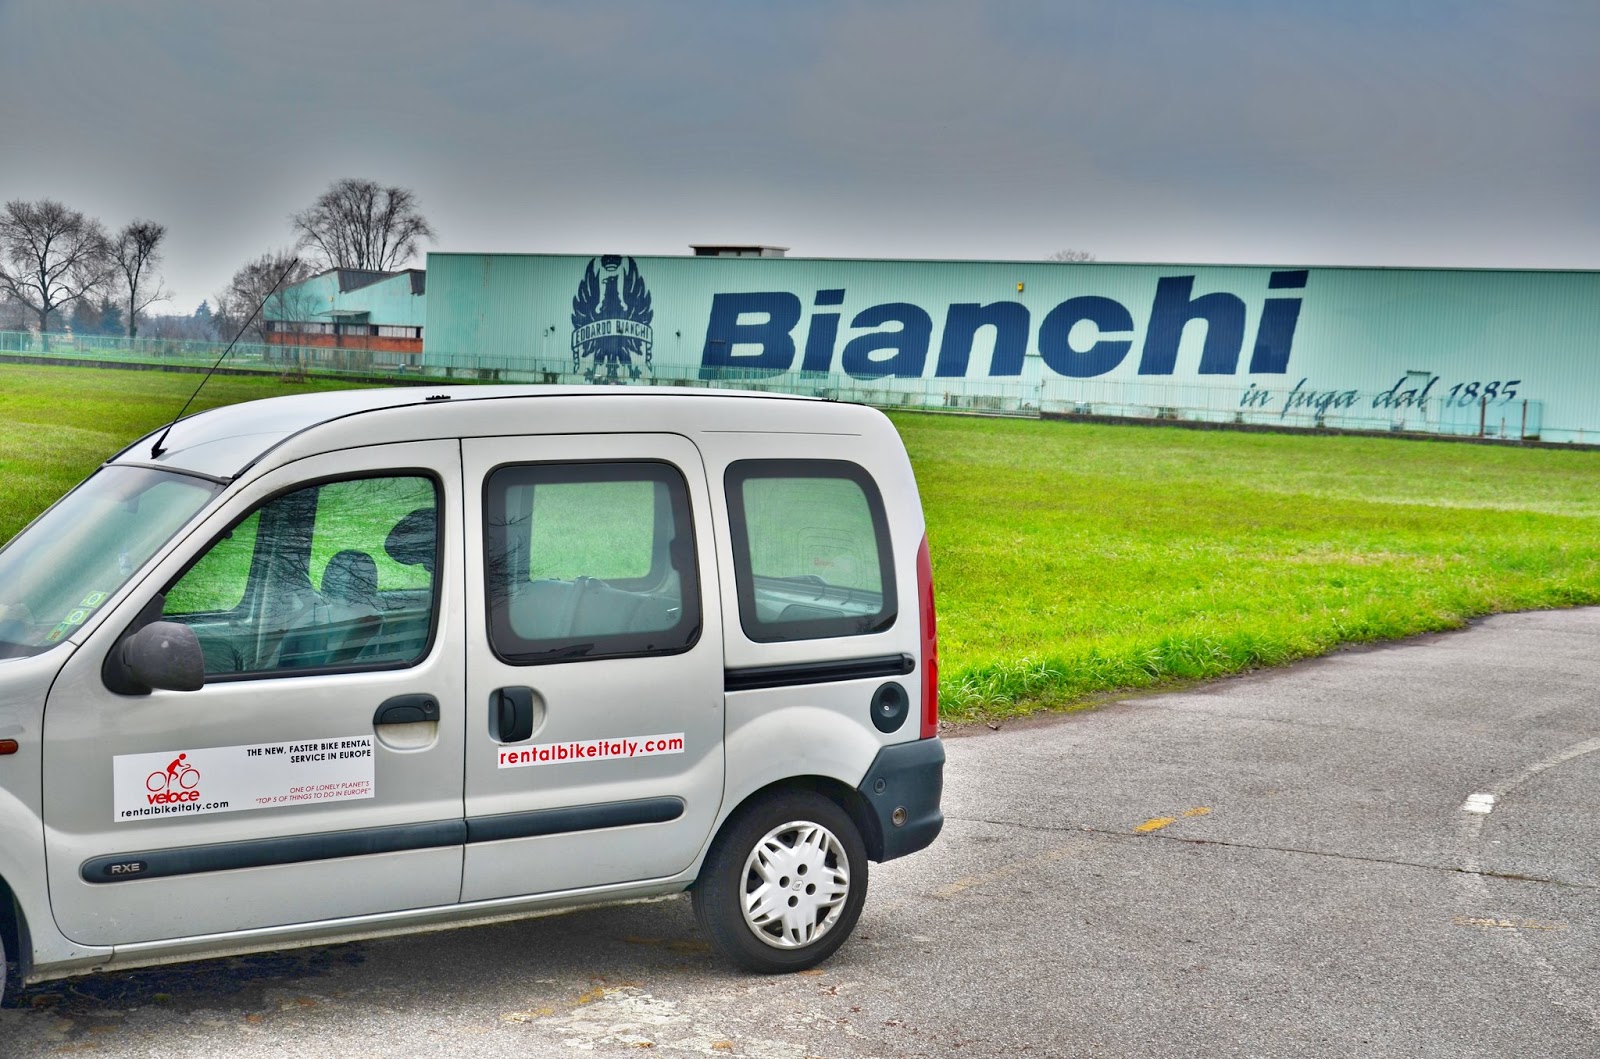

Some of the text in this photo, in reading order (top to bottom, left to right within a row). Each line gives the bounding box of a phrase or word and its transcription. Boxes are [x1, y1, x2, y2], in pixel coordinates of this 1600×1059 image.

[576, 320, 649, 345] EDOARDO BIANCHI
[699, 270, 1309, 380] Bianchi
[1240, 376, 1521, 419] in fuga dal 1885
[247, 739, 371, 757] THE NEW, FASTER BIKE RENTAL
[291, 749, 371, 764] SERVICE IN EUROPE
[500, 737, 683, 765] rentalbikeitaly.com
[290, 781, 370, 794] ONE OF LONELY PLANET'S
[147, 789, 200, 805] veloce
[279, 795, 288, 803] OF
[289, 792, 312, 801] THINGS
[314, 791, 322, 799] TO
[323, 790, 334, 798] DO
[121, 801, 229, 818] rentalbikeitaly.com
[111, 863, 140, 874] RXE
